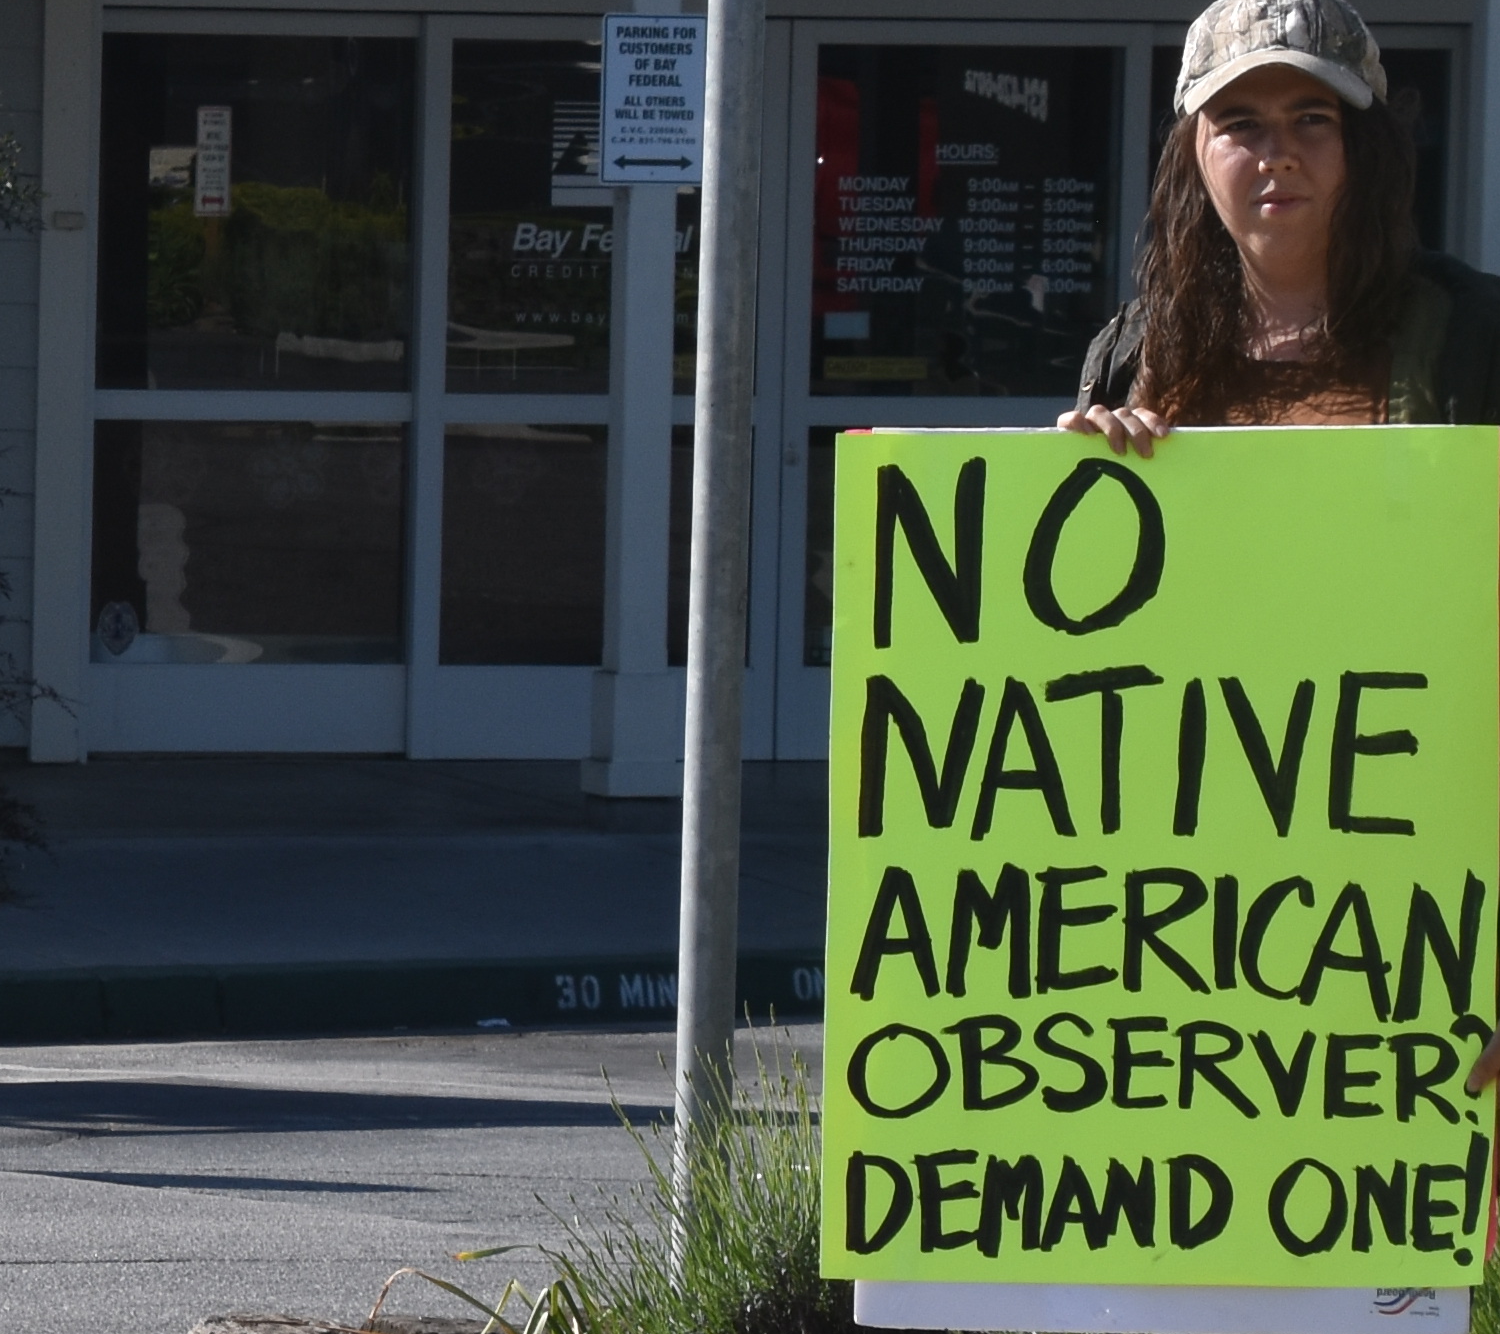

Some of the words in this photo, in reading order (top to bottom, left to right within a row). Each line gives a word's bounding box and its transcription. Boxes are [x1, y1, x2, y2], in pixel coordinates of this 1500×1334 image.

[616, 26, 669, 39] PARKING
[673, 27, 697, 39] FOR
[619, 42, 693, 55] CUSTOMERS
[634, 58, 650, 71] OF
[653, 58, 677, 71] BAY
[628, 74, 682, 87] FEDERAL
[624, 95, 642, 107] ALL
[645, 96, 686, 107] OTHERS
[614, 108, 639, 120] WILL
[642, 109, 657, 120] BE
[659, 109, 694, 121] TOWED
[935, 144, 999, 161] HOURS:
[838, 176, 910, 192] MONDAY
[838, 196, 915, 212] TUESDAY
[838, 217, 944, 232] WEDNESDAY
[512, 222, 572, 259] Bay
[838, 236, 927, 252] THURSDAY
[836, 257, 895, 272] FRIDAY
[836, 277, 925, 293] SATURDAY
[873, 456, 1167, 649] NO
[858, 665, 1428, 841] NATIVE
[850, 862, 1486, 1022] AMERICAN
[555, 975, 600, 1010] 30
[845, 1149, 1234, 1259] DEMAND
[1268, 1131, 1490, 1265] ONE!
